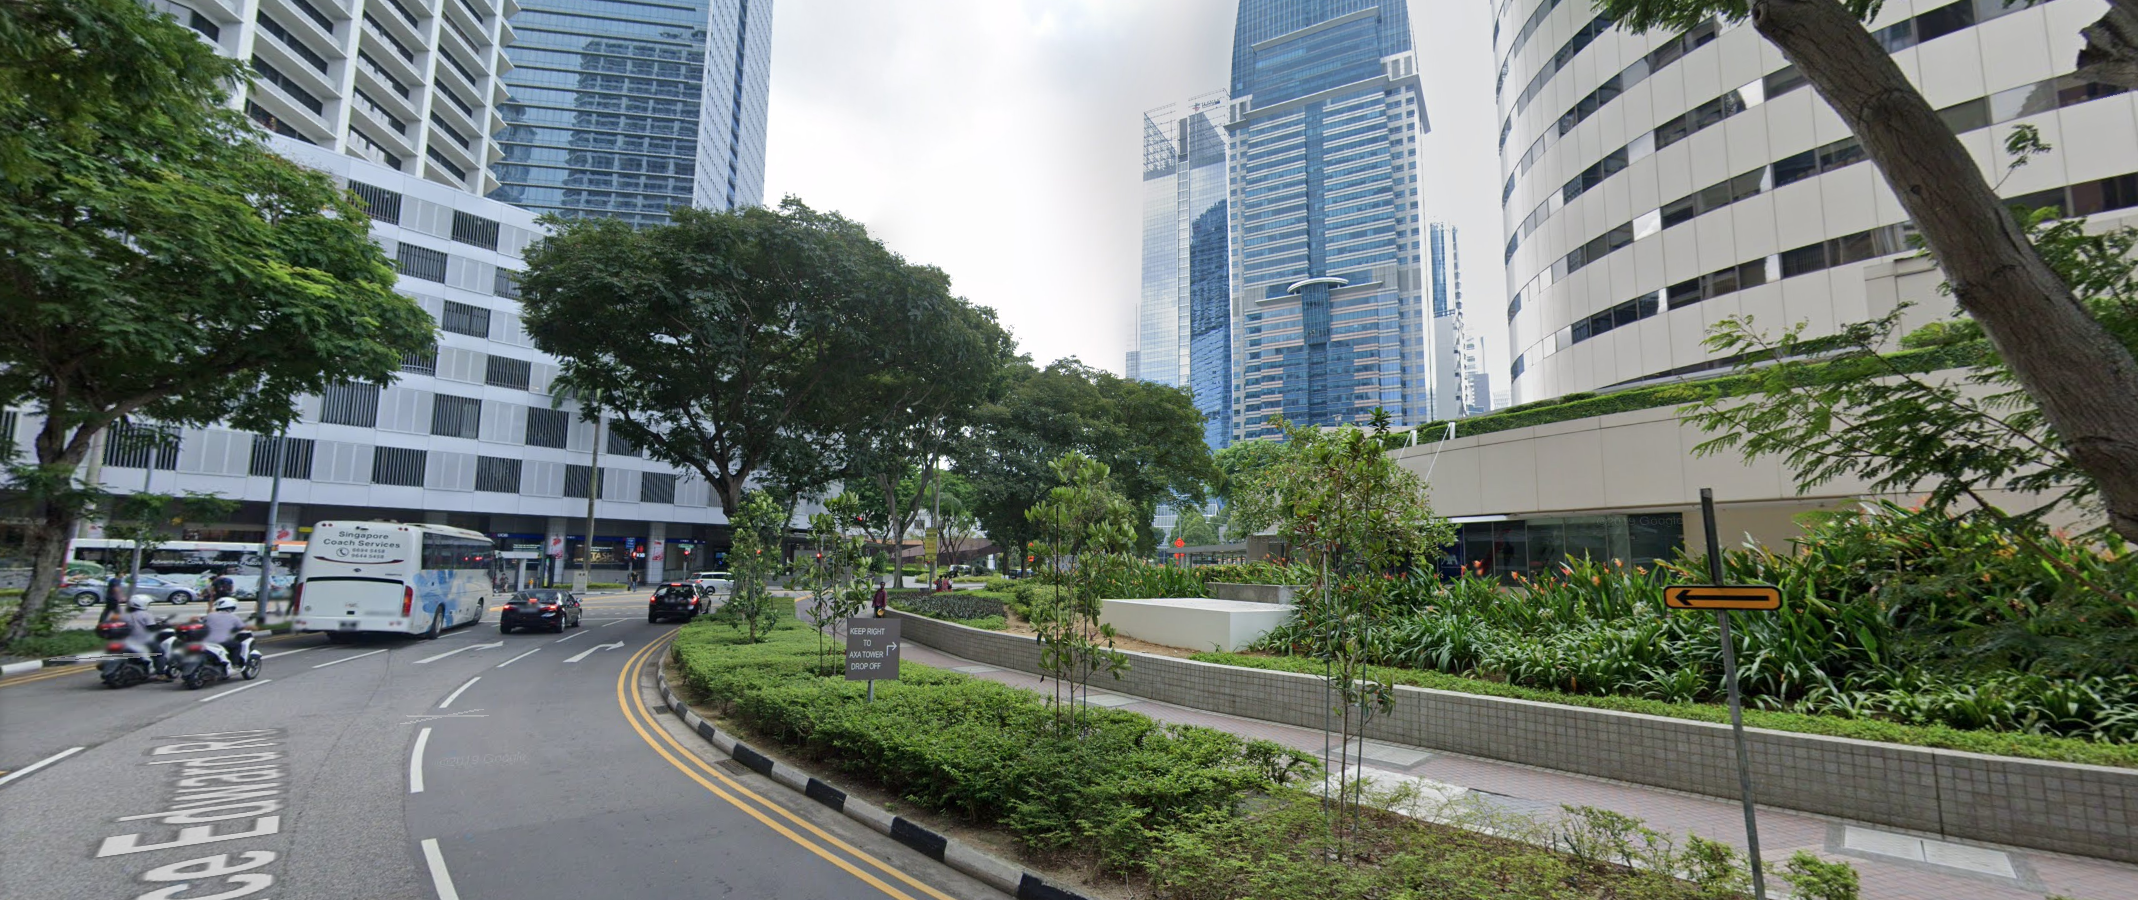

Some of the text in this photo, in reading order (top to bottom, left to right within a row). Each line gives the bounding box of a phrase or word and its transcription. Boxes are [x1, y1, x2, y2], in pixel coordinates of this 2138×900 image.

[339, 531, 389, 540] Singapore
[323, 538, 401, 548] Coach Services
[96, 752, 281, 857] Edward
